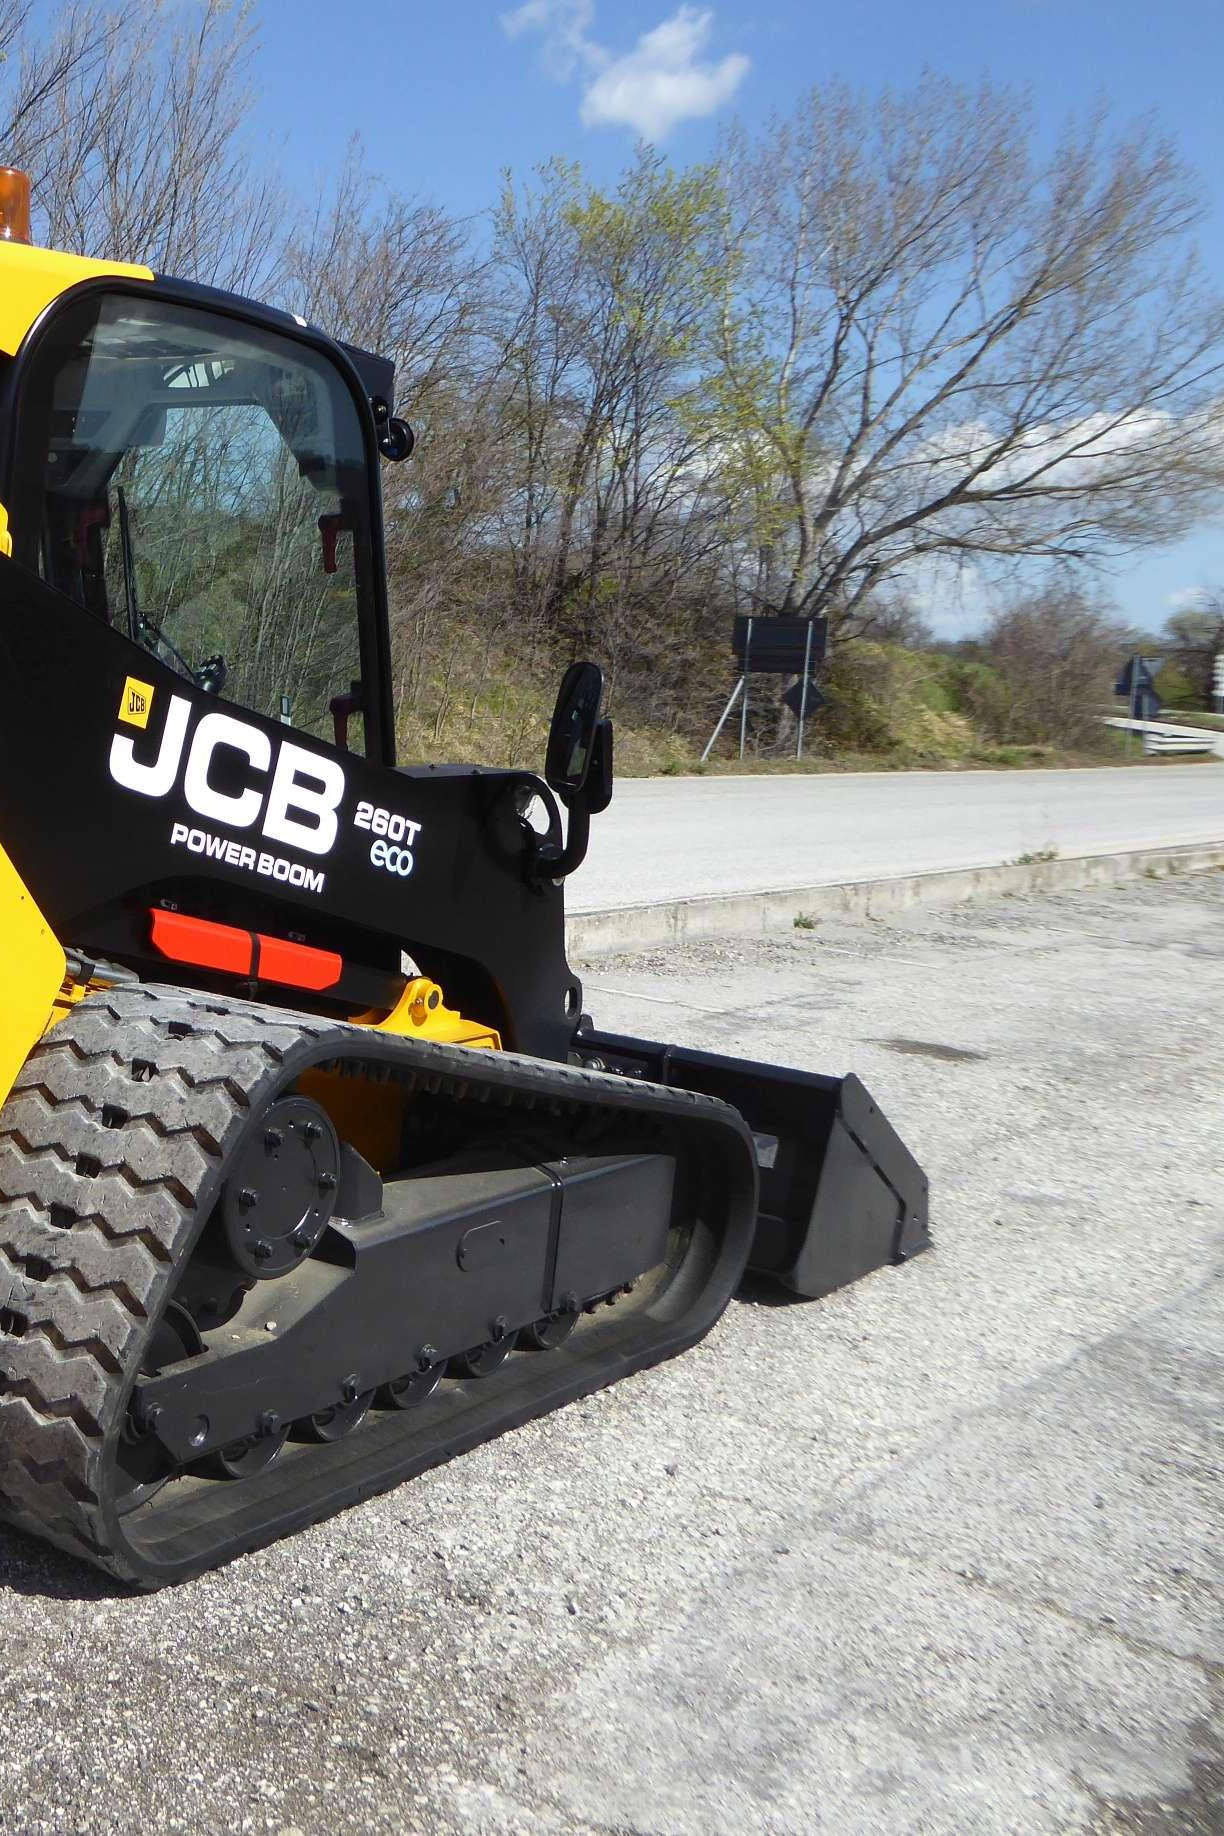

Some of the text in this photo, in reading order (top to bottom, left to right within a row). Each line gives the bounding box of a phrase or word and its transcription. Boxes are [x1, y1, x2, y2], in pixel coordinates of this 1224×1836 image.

[129, 691, 145, 713] JCB
[109, 694, 345, 855] JCB
[353, 801, 422, 846] 260T
[370, 839, 414, 877] eco
